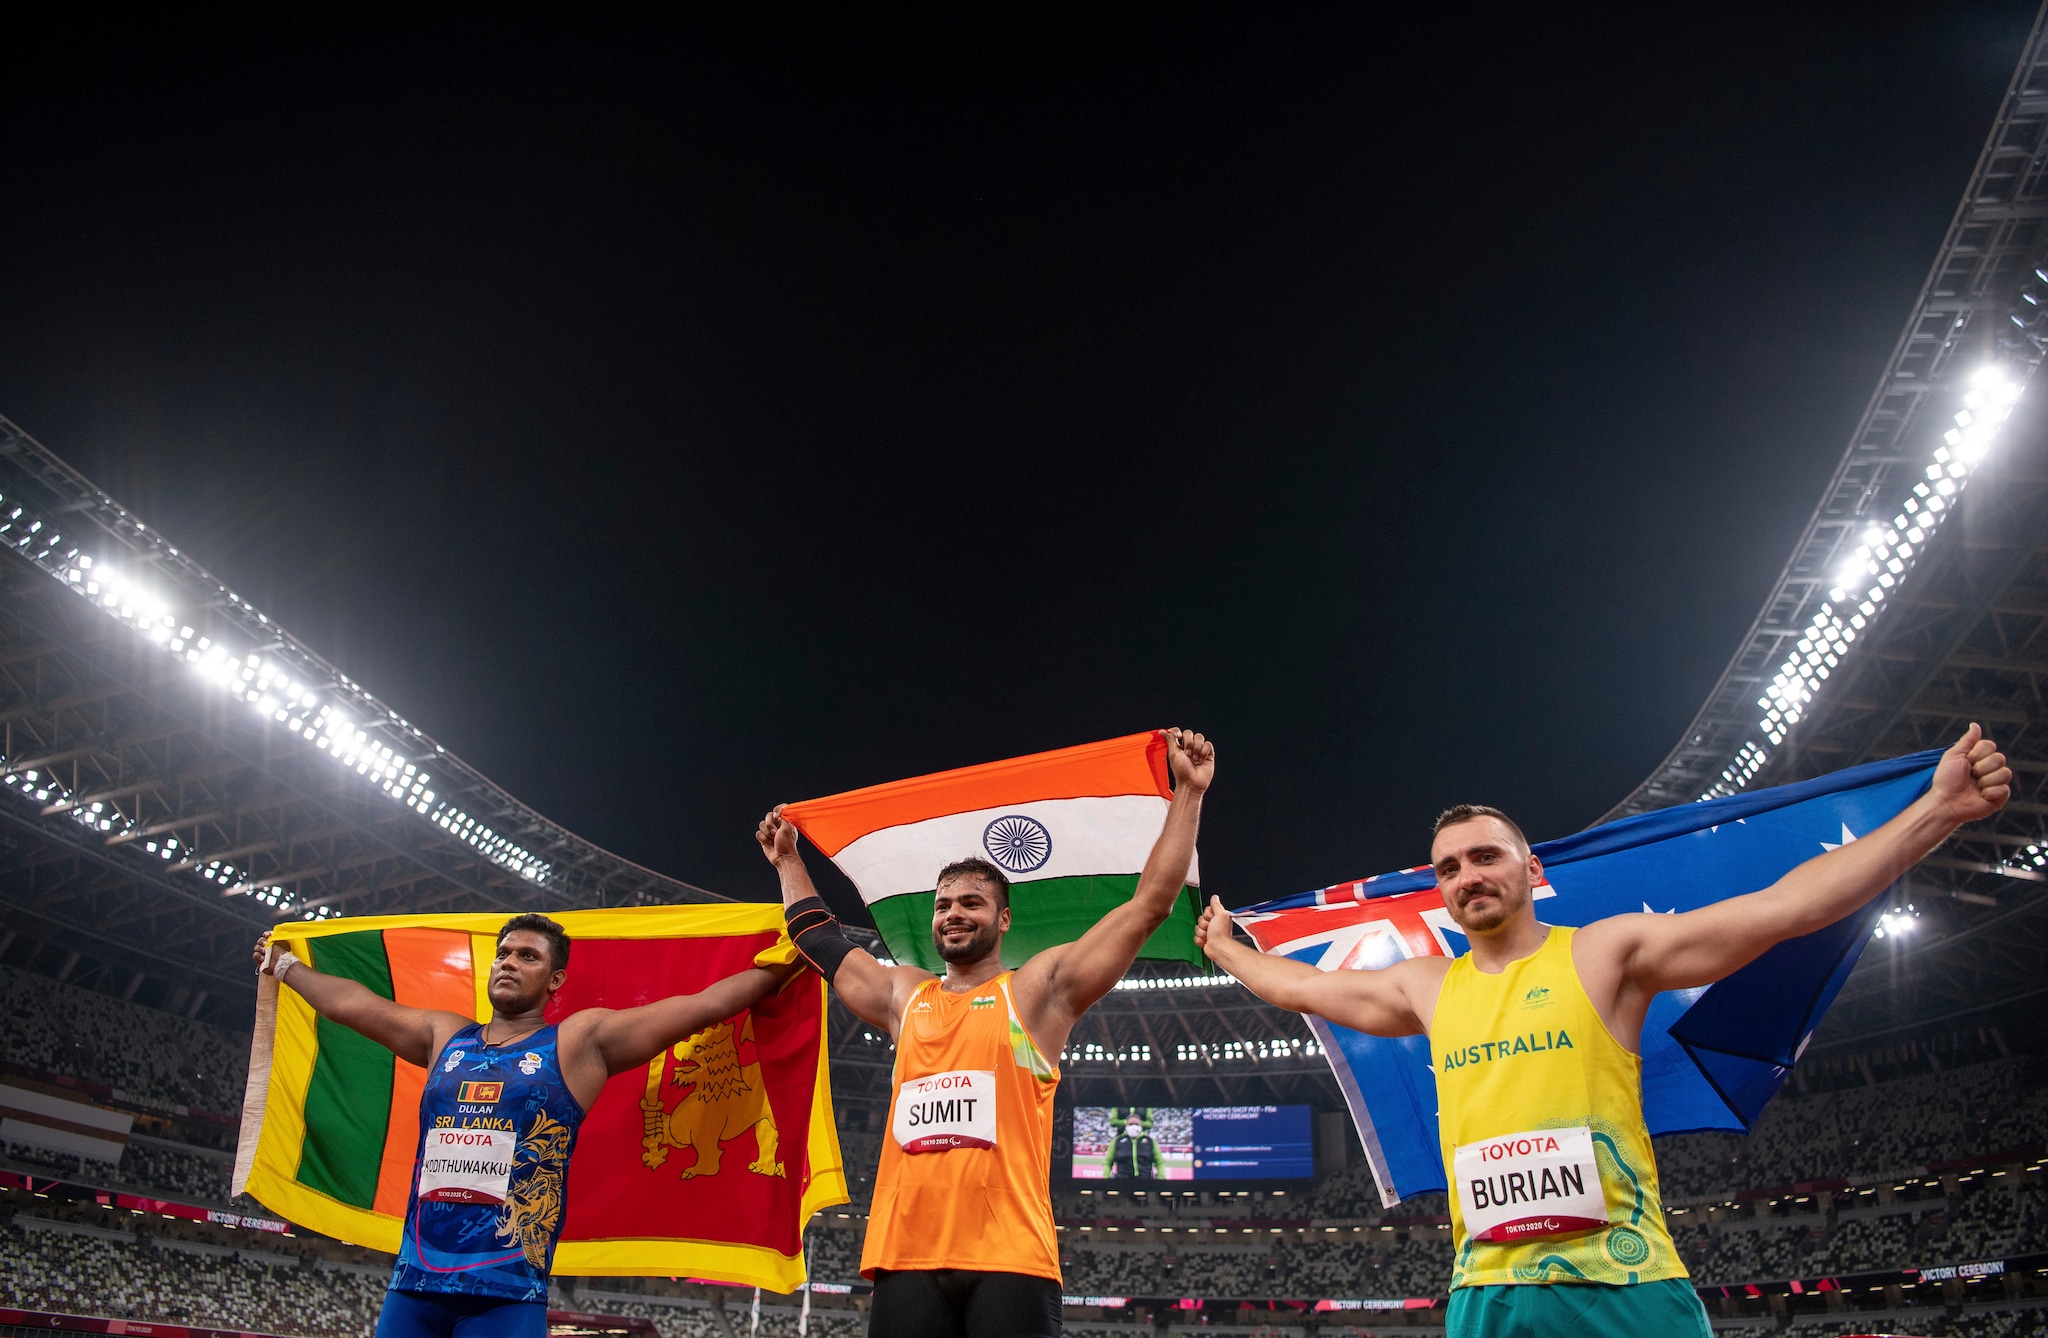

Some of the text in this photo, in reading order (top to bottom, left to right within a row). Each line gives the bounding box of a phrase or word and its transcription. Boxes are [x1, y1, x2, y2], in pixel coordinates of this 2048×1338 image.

[1444, 1029, 1574, 1073] AUSTRALIA
[917, 1075, 972, 1094] TOYOTA
[458, 1104, 494, 1114] DULAN
[908, 1098, 978, 1127] SUMIT
[1227, 1112, 1260, 1120] CEREMONY
[435, 1115, 514, 1131] SRI LANKA
[439, 1133, 493, 1146] TOYOTA
[1479, 1136, 1560, 1162] TOYOTA
[424, 1159, 508, 1176] KODITHUWAKKU
[1470, 1163, 1585, 1210] BURIAN
[207, 1210, 287, 1233] VICTORY CEREMONY
[1505, 1221, 1543, 1234] TOKYO 2020
[1920, 1261, 2004, 1281] VICTORY CEREMONY
[810, 1282, 853, 1294] CEREMONY
[1085, 1296, 1126, 1308] CEREMONY
[1329, 1299, 1405, 1310] VICTORY CEREMONY
